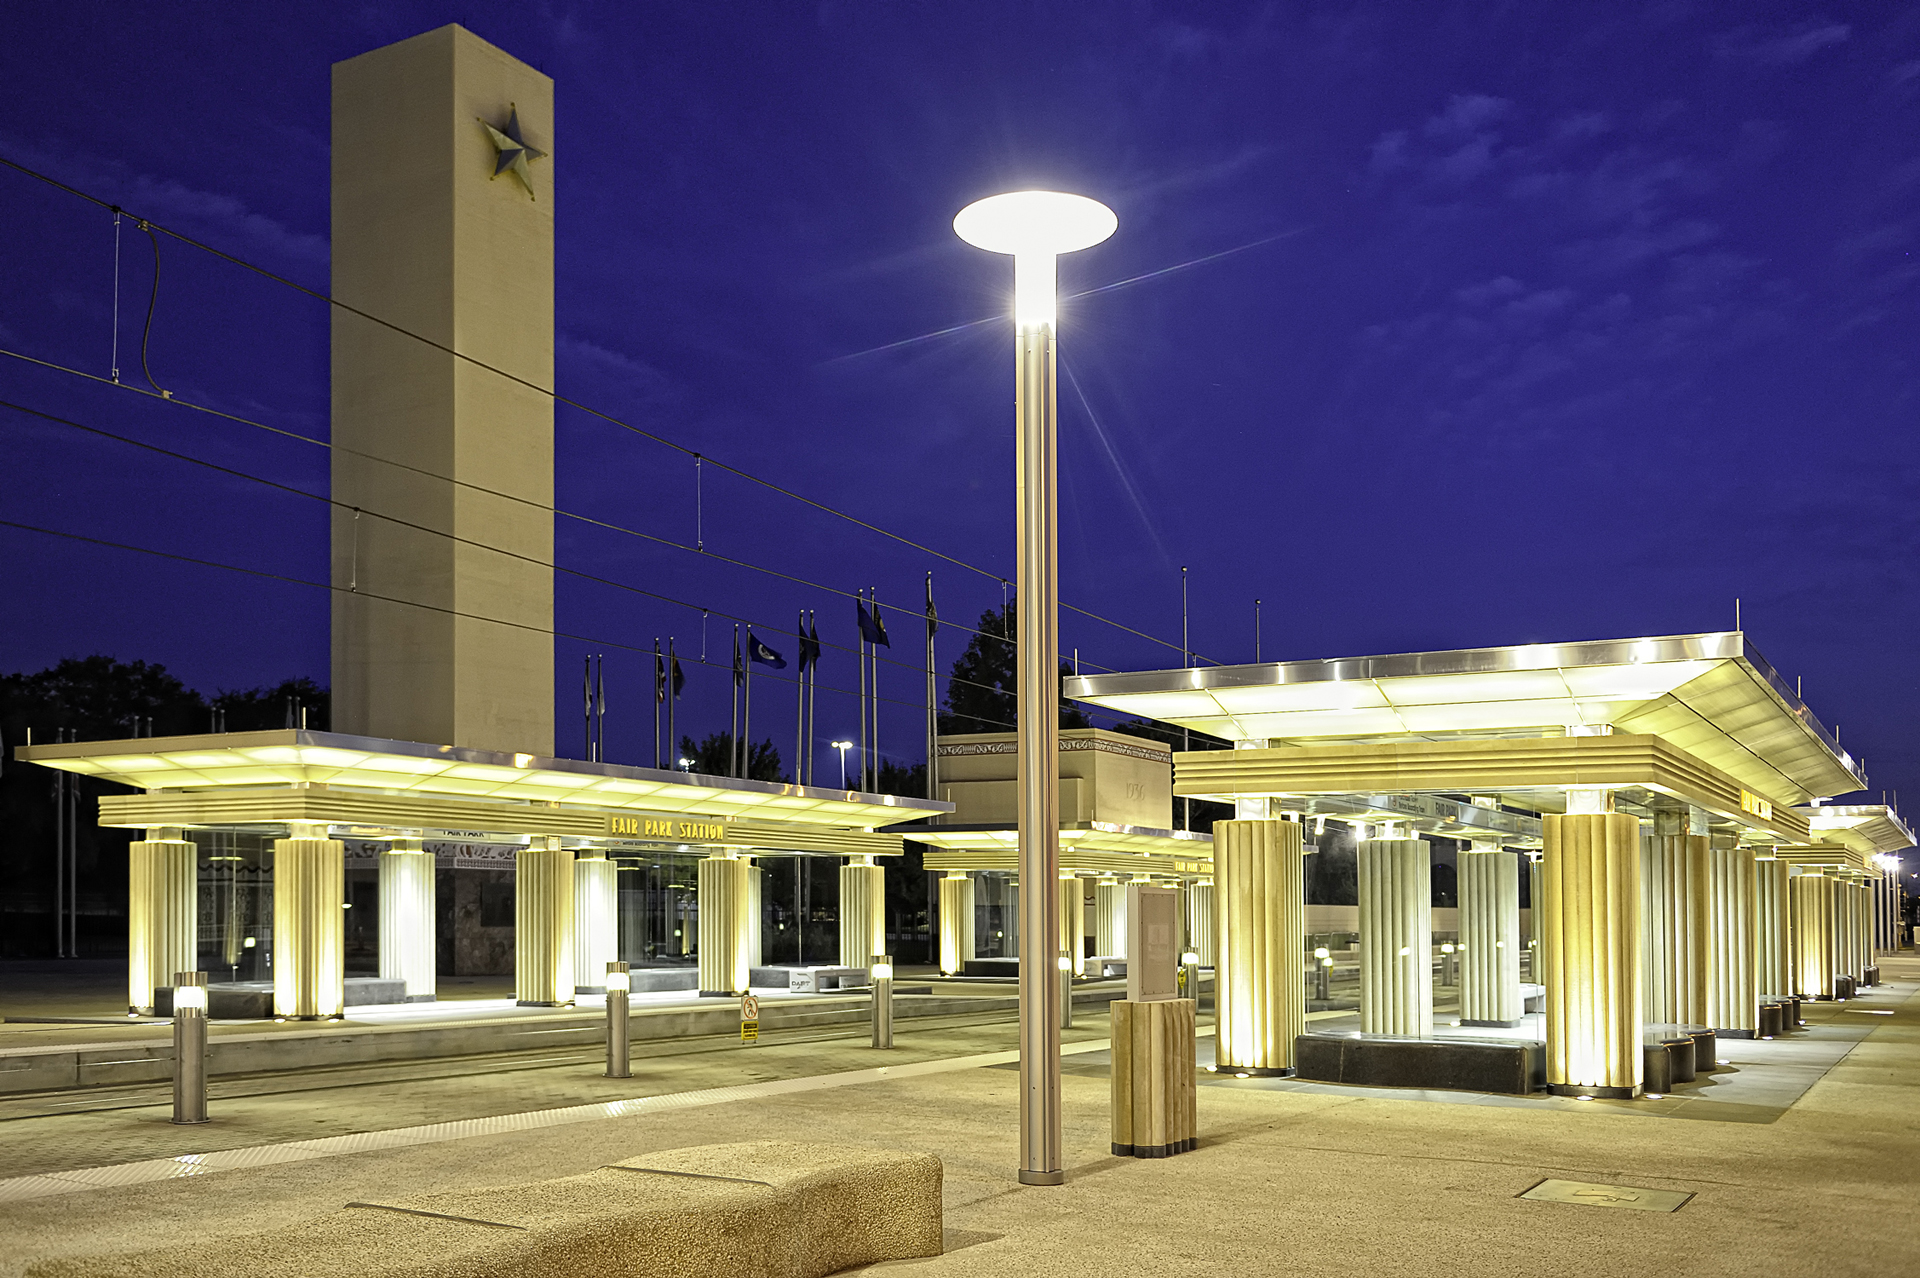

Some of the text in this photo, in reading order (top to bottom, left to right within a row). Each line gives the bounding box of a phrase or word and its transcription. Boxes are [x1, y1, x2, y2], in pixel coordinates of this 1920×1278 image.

[1126, 782, 1145, 801] 1936
[1435, 802, 1446, 816] FAIR
[611, 817, 724, 840] FAIR PARK STATION
[1175, 861, 1215, 873] FAIR PARK STATIO
